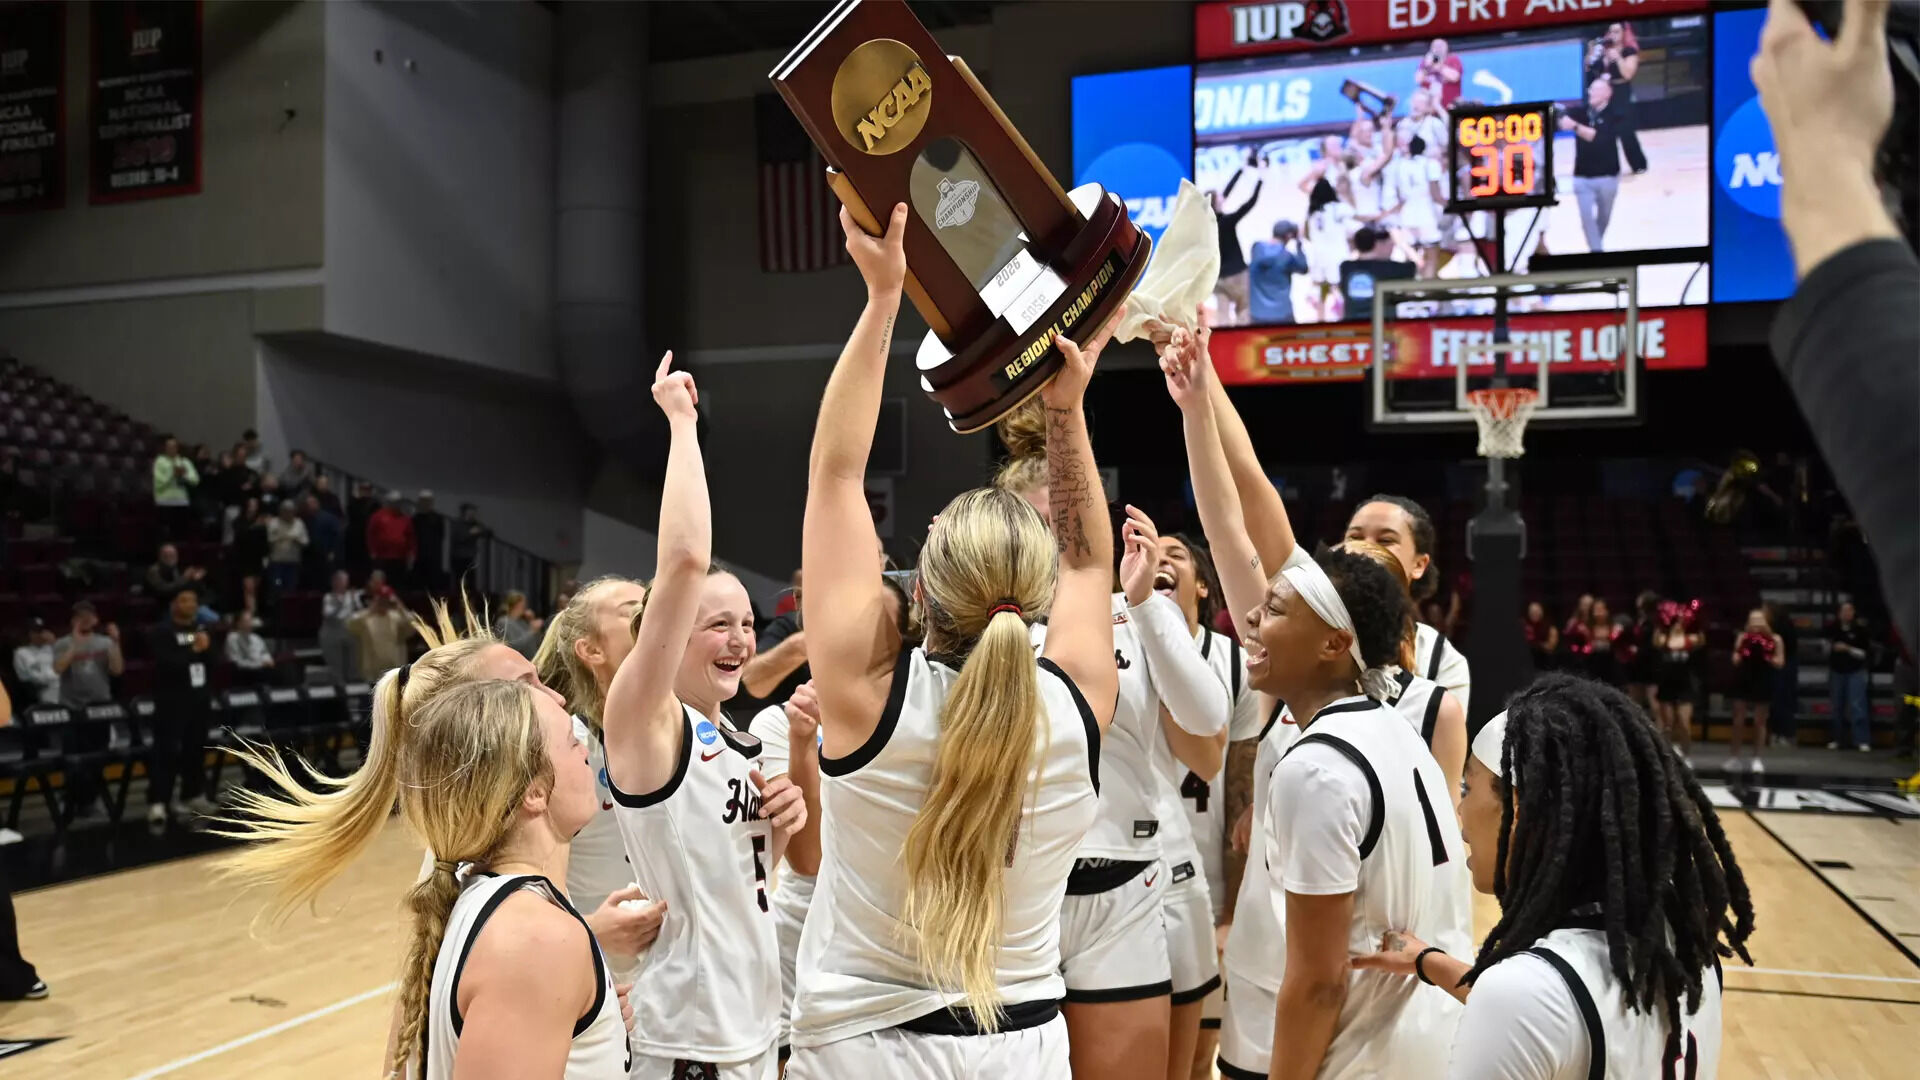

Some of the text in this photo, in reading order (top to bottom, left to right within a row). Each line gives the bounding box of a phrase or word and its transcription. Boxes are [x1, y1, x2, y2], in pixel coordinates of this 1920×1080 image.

[1233, 2, 1305, 44] IUP
[1388, 0, 1437, 29] ED
[132, 27, 162, 50] IUP
[857, 63, 931, 151] NCAA
[1459, 112, 1542, 147] 60:00
[1470, 144, 1534, 197] 30
[1004, 259, 1116, 381] REGIONAL CHAMPION
[1180, 770, 1211, 813] 4
[1412, 766, 1450, 867] 1
